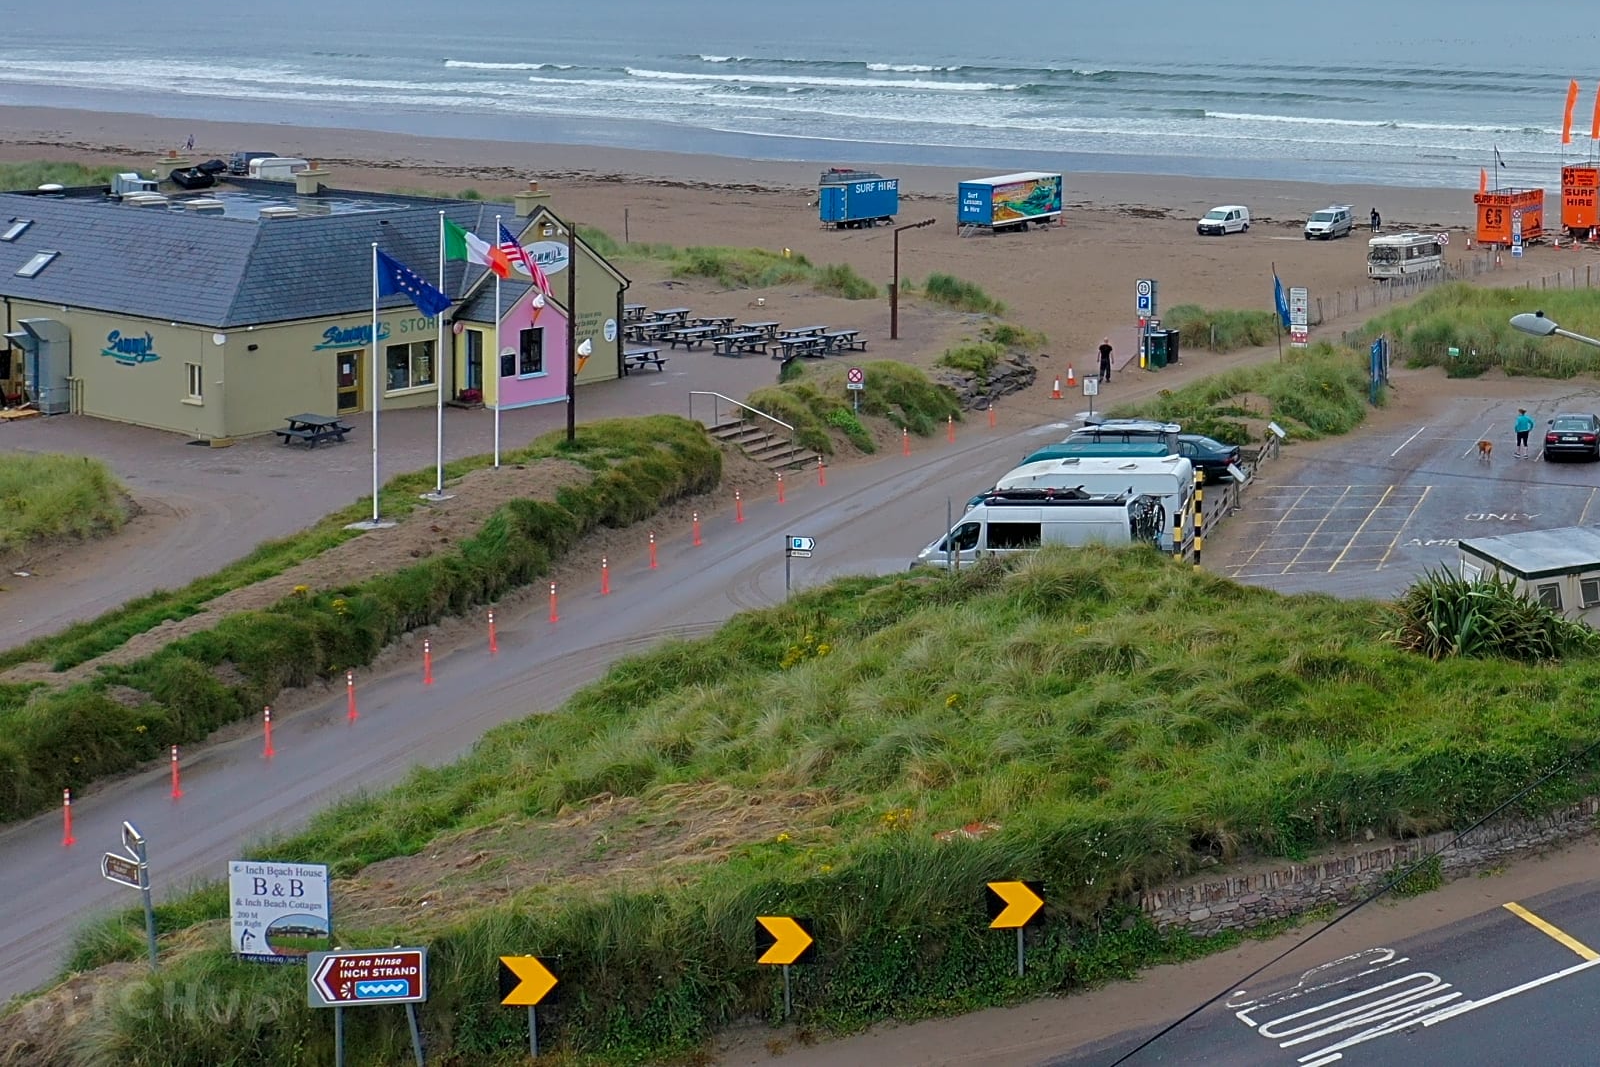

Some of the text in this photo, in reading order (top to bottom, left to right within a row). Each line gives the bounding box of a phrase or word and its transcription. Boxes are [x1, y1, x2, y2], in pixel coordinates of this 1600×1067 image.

[1563, 168, 1575, 185] €5
[855, 180, 896, 194] SURF HIRE
[1564, 188, 1594, 196] SURF
[1474, 194, 1510, 204] SURF HIRE
[1566, 198, 1592, 206] HIRE
[1486, 208, 1502, 226] €5
[1140, 298, 1147, 308] P
[246, 866, 322, 878] Inch Beach House
[252, 876, 304, 898] B & B
[235, 898, 322, 911] & Inch Beach Cottages
[244, 920, 262, 929] Right
[374, 958, 402, 966] hInse
[340, 966, 417, 978] INCH STRAND
